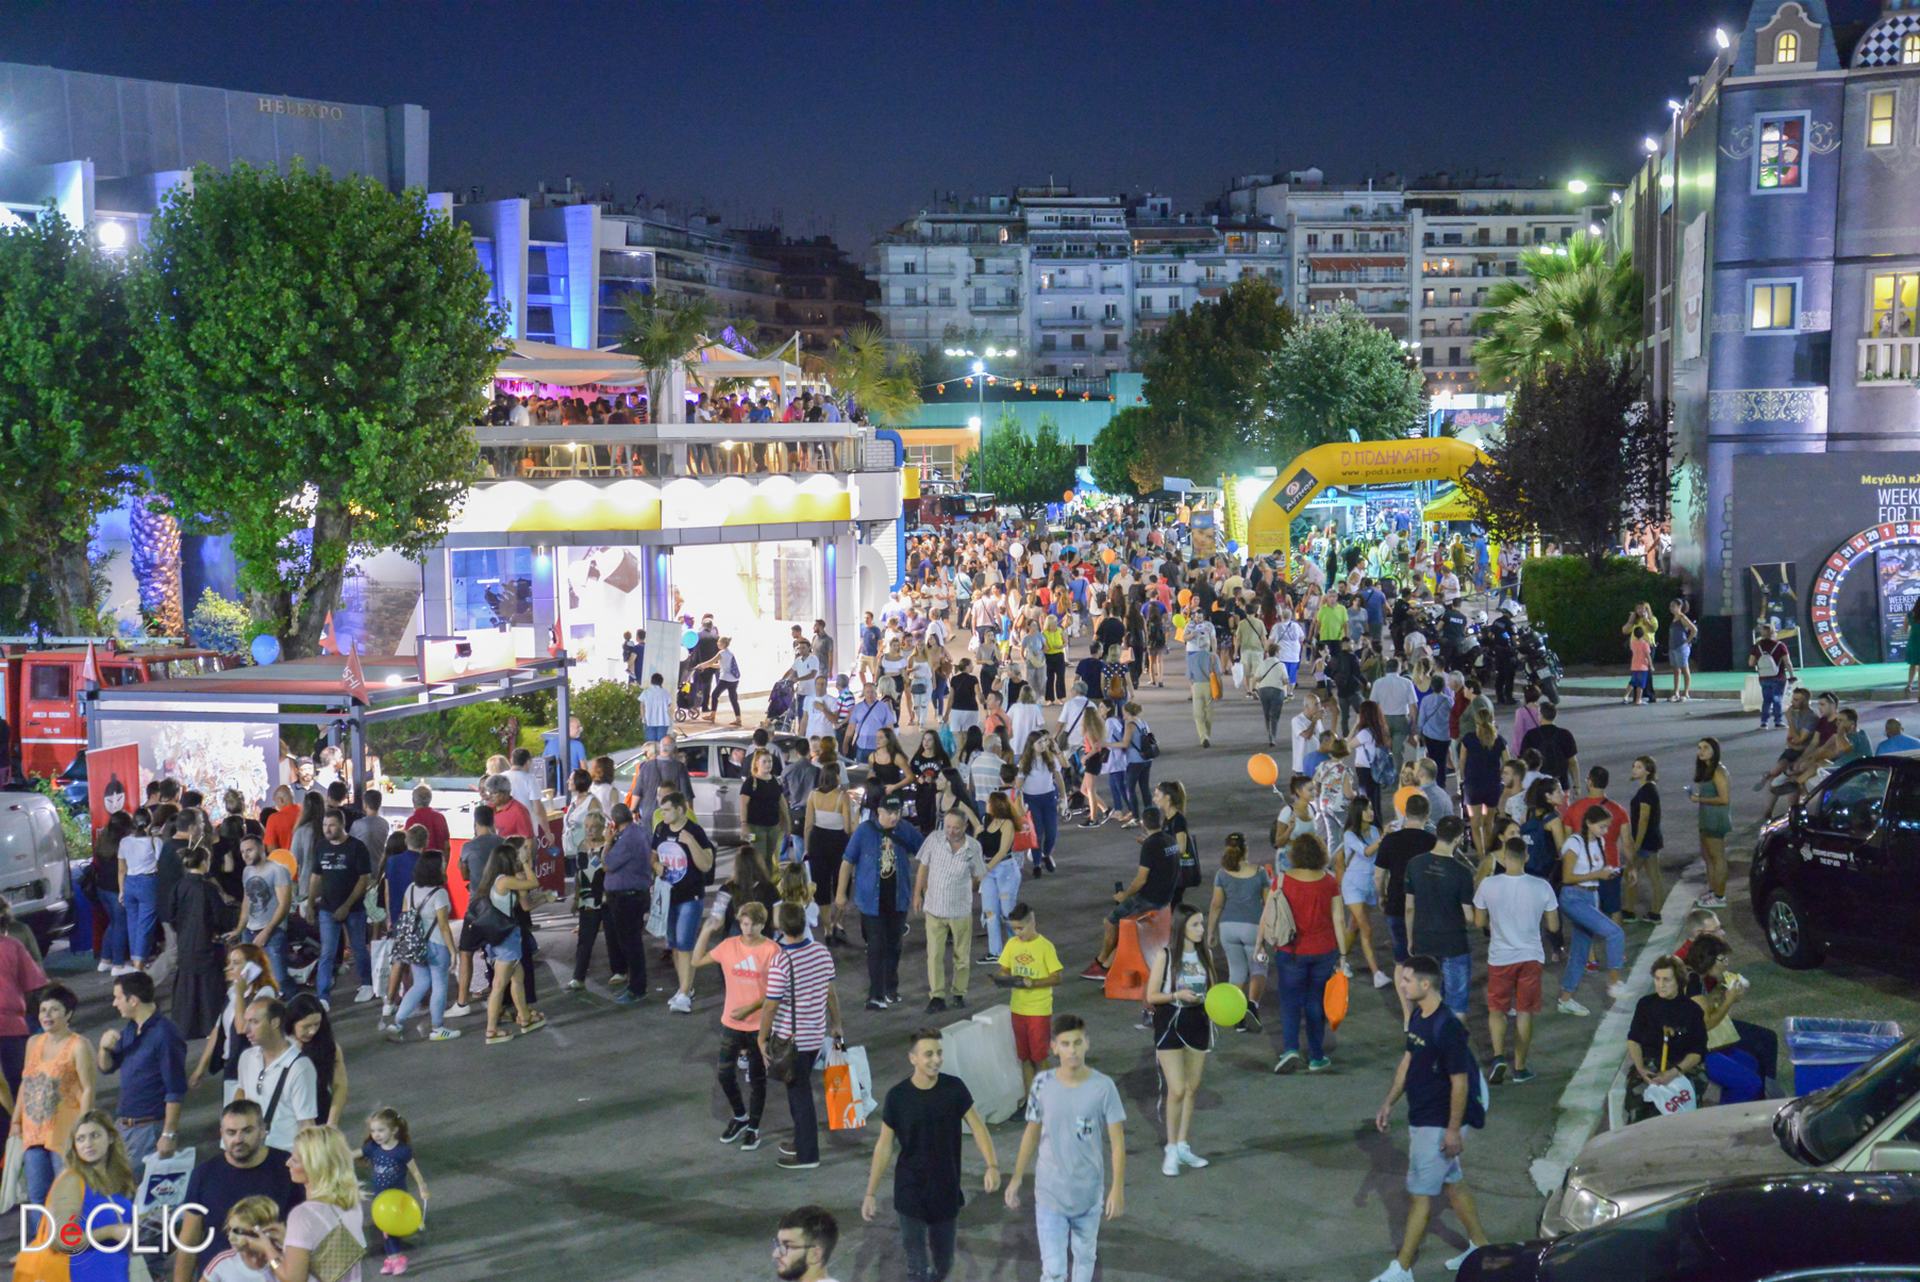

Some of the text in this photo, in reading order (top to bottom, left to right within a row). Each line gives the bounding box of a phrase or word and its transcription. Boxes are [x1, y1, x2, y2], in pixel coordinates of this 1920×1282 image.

[259, 97, 343, 121] HELEXPO
[1861, 474, 1905, 486] Μεγάλη
[1285, 479, 1315, 512] AUTHOR
[1878, 488, 1920, 505] WEEK
[1879, 506, 1920, 523] FOR T
[1883, 528, 1890, 537] 1
[1896, 524, 1909, 534] 33
[1866, 530, 1879, 542] 20
[1853, 538, 1866, 550] 14
[1841, 546, 1855, 559] 31
[1823, 569, 1837, 581] 22
[1819, 582, 1830, 592] 18
[1816, 594, 1828, 606] 29
[1889, 595, 1917, 604] WEEKEN
[1889, 603, 1914, 613] FOR TW
[1817, 621, 1829, 633] 28
[1822, 634, 1834, 645] 12
[535, 861, 556, 878] USHI
